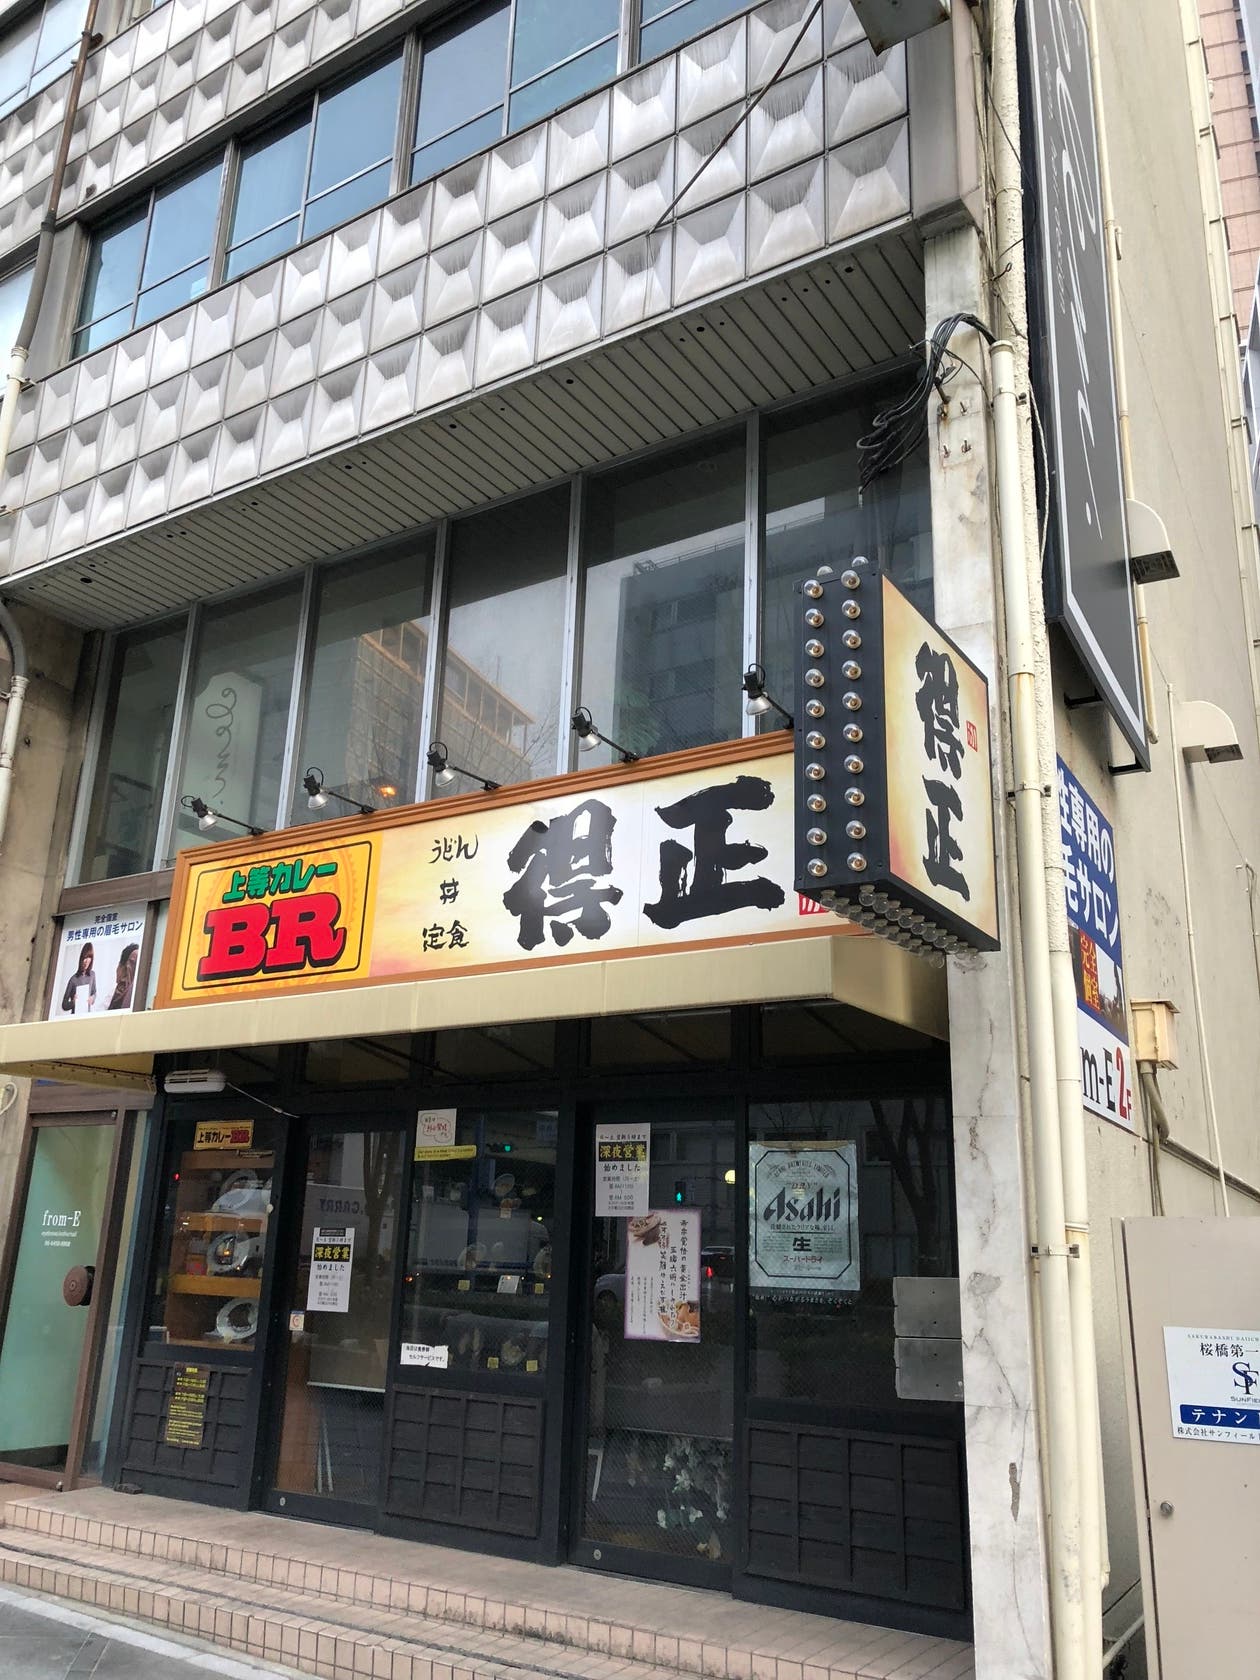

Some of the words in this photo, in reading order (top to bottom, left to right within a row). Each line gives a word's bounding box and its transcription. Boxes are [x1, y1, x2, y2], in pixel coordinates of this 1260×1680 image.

[914, 641, 971, 901] 得正
[428, 834, 479, 864] うどん
[502, 775, 786, 951] 得正
[222, 858, 338, 905] 上等カレー
[439, 877, 459, 905] 丼
[66, 921, 144, 942] 男性専用の眉毛サロン
[197, 891, 347, 982] BR
[422, 919, 470, 953] 定食
[198, 1130, 231, 1144] 上等カレー
[603, 1163, 641, 1172] 始めました
[763, 1187, 840, 1221] Asahi
[42, 1210, 82, 1226] from-E
[315, 1246, 350, 1260] 深夜営業
[792, 1236, 812, 1252] 生
[317, 1263, 345, 1272] 始めました
[1199, 1342, 1260, 1358] 桜橋第一
